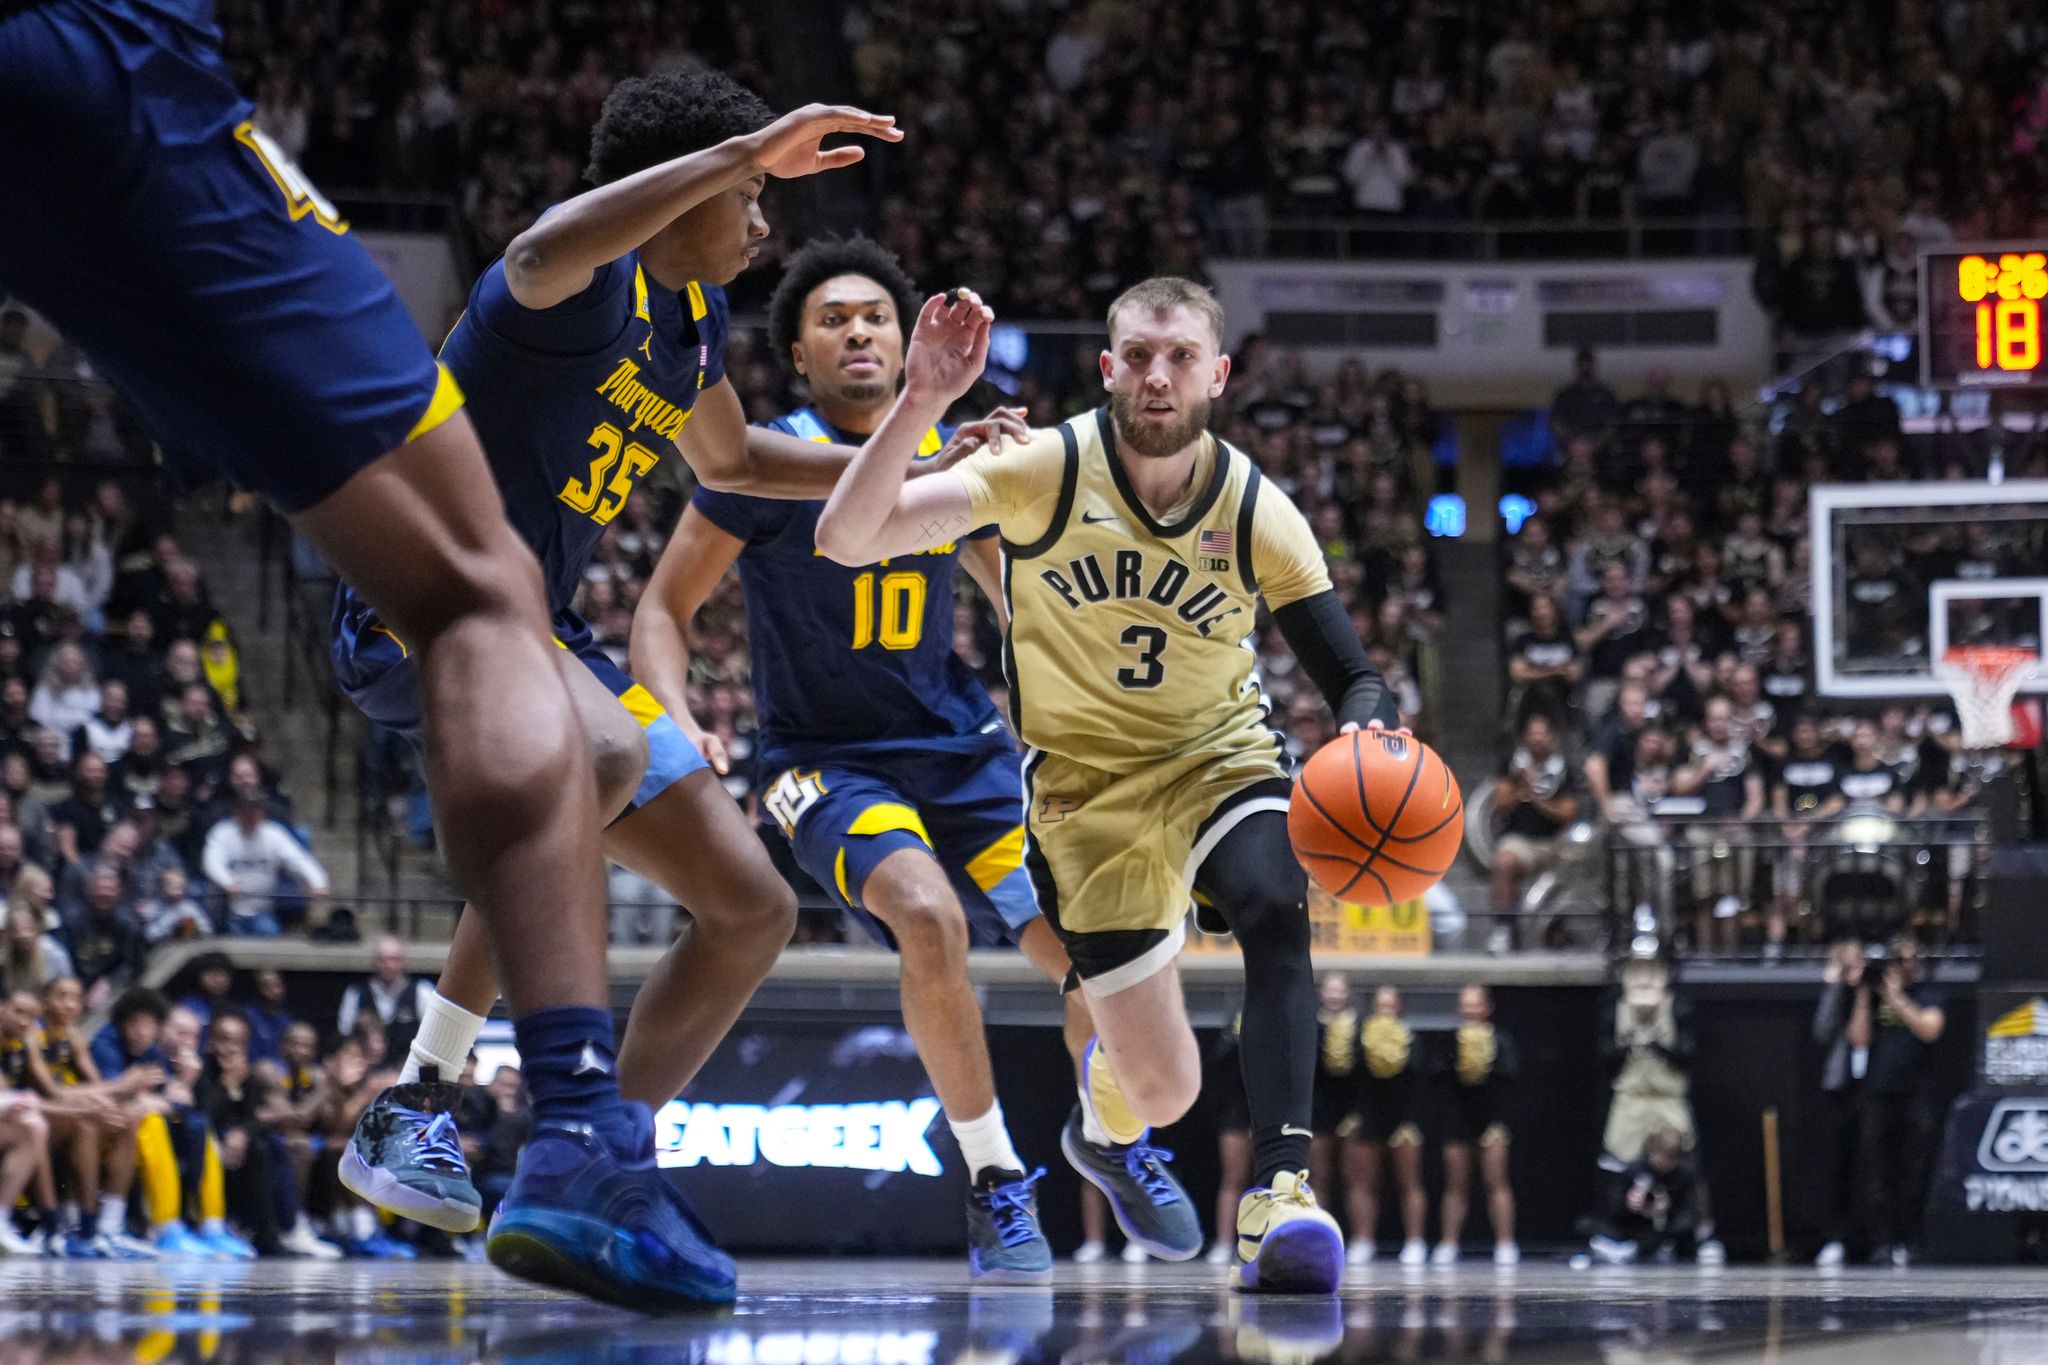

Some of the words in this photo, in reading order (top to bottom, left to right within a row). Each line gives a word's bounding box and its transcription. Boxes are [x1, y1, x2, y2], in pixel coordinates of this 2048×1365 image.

[1975, 299, 2042, 371] 18
[594, 356, 694, 442] Marquet
[556, 421, 660, 526] 35
[852, 571, 928, 650] 10
[1040, 549, 1243, 638] PURDUE
[1116, 624, 1168, 689] 3
[654, 1096, 944, 1177] EATGEEK
